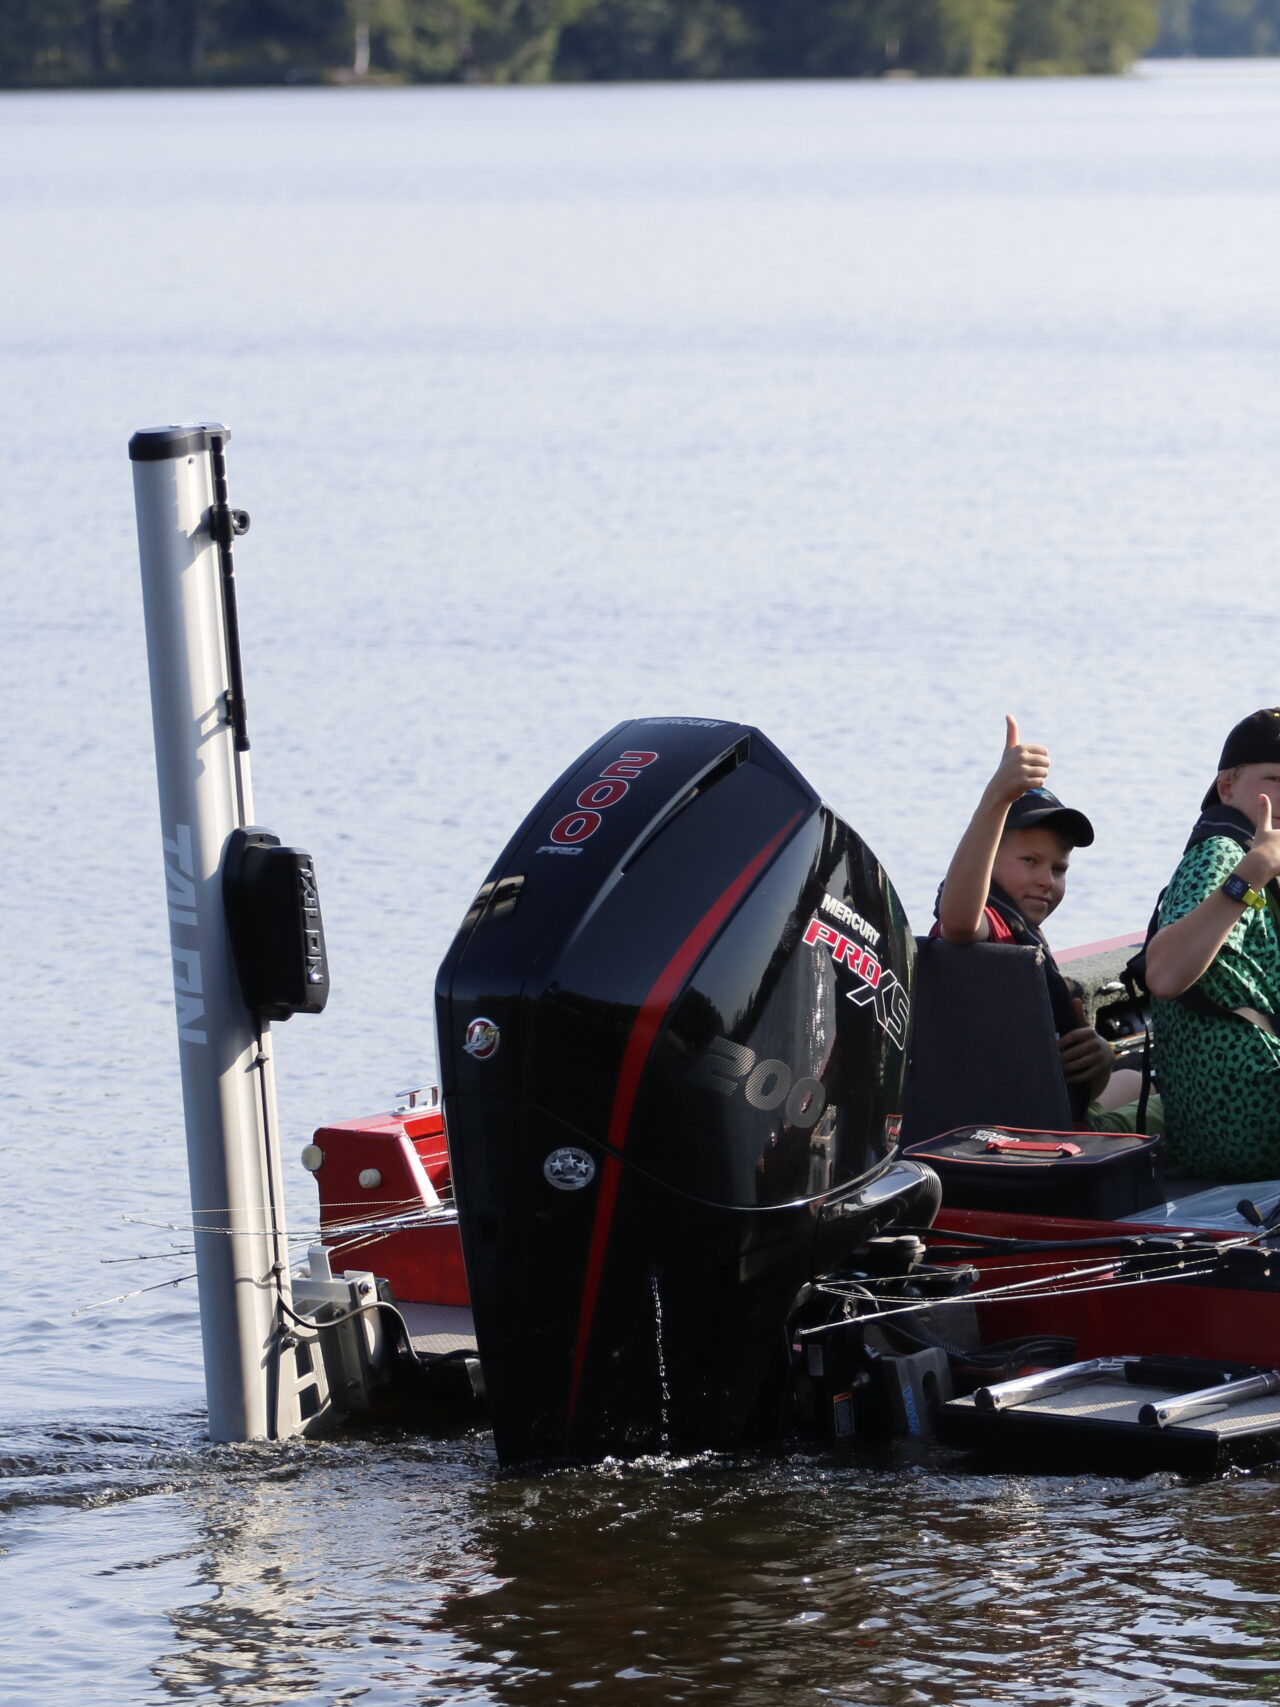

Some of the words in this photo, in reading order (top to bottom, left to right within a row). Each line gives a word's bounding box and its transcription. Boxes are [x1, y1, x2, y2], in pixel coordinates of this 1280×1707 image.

[550, 750, 659, 845] 200
[163, 824, 208, 1045] TALON
[820, 893, 881, 946] MERCURY
[698, 1035, 826, 1129] 200
